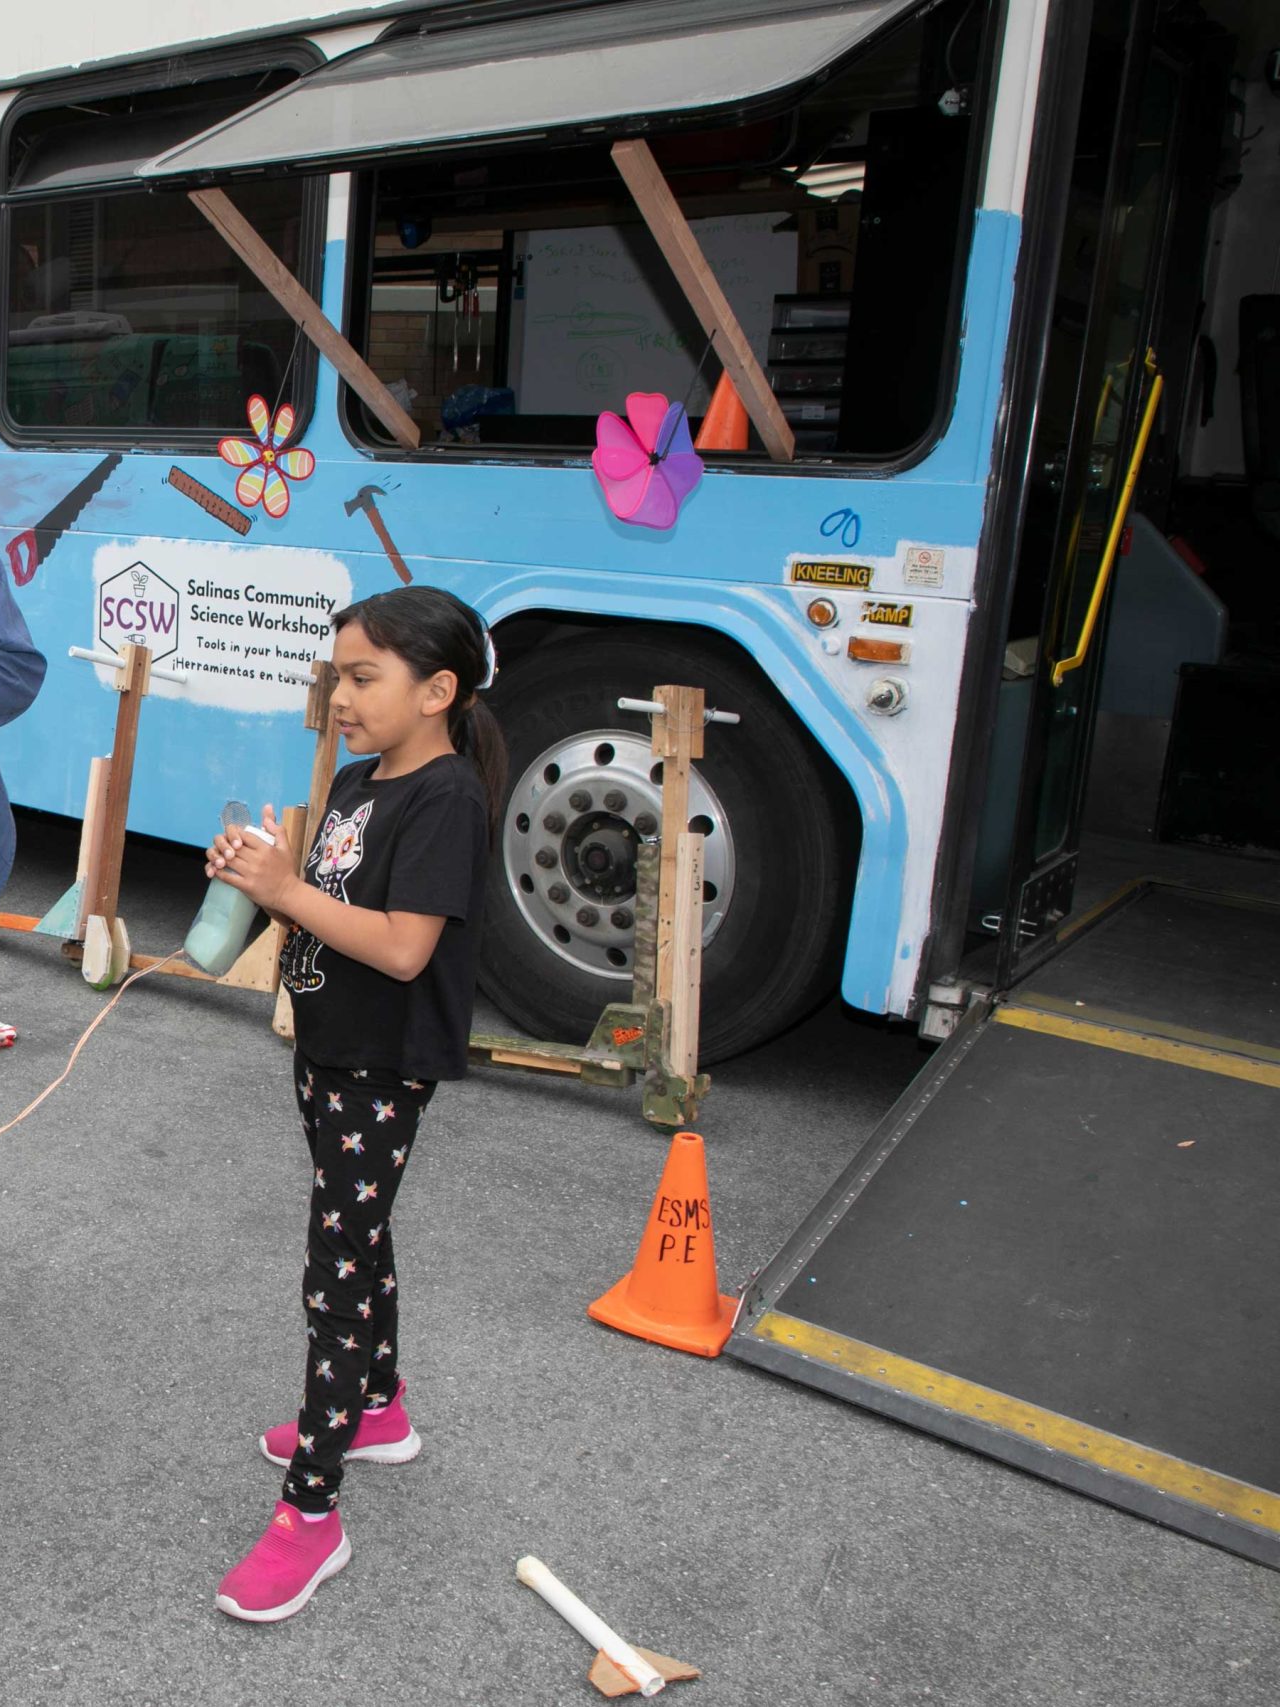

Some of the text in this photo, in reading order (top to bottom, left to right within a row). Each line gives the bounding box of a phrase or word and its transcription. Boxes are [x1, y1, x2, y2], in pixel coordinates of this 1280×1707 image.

[796, 564, 869, 584] KNEELING
[187, 579, 336, 615] Salinas Community
[103, 596, 176, 634] SCSW
[190, 604, 330, 640] Science Workshop
[196, 636, 317, 662] Tools in your hands!
[172, 657, 255, 679] ¡Herramientas
[259, 671, 273, 681] en
[658, 1196, 711, 1231] ESMS
